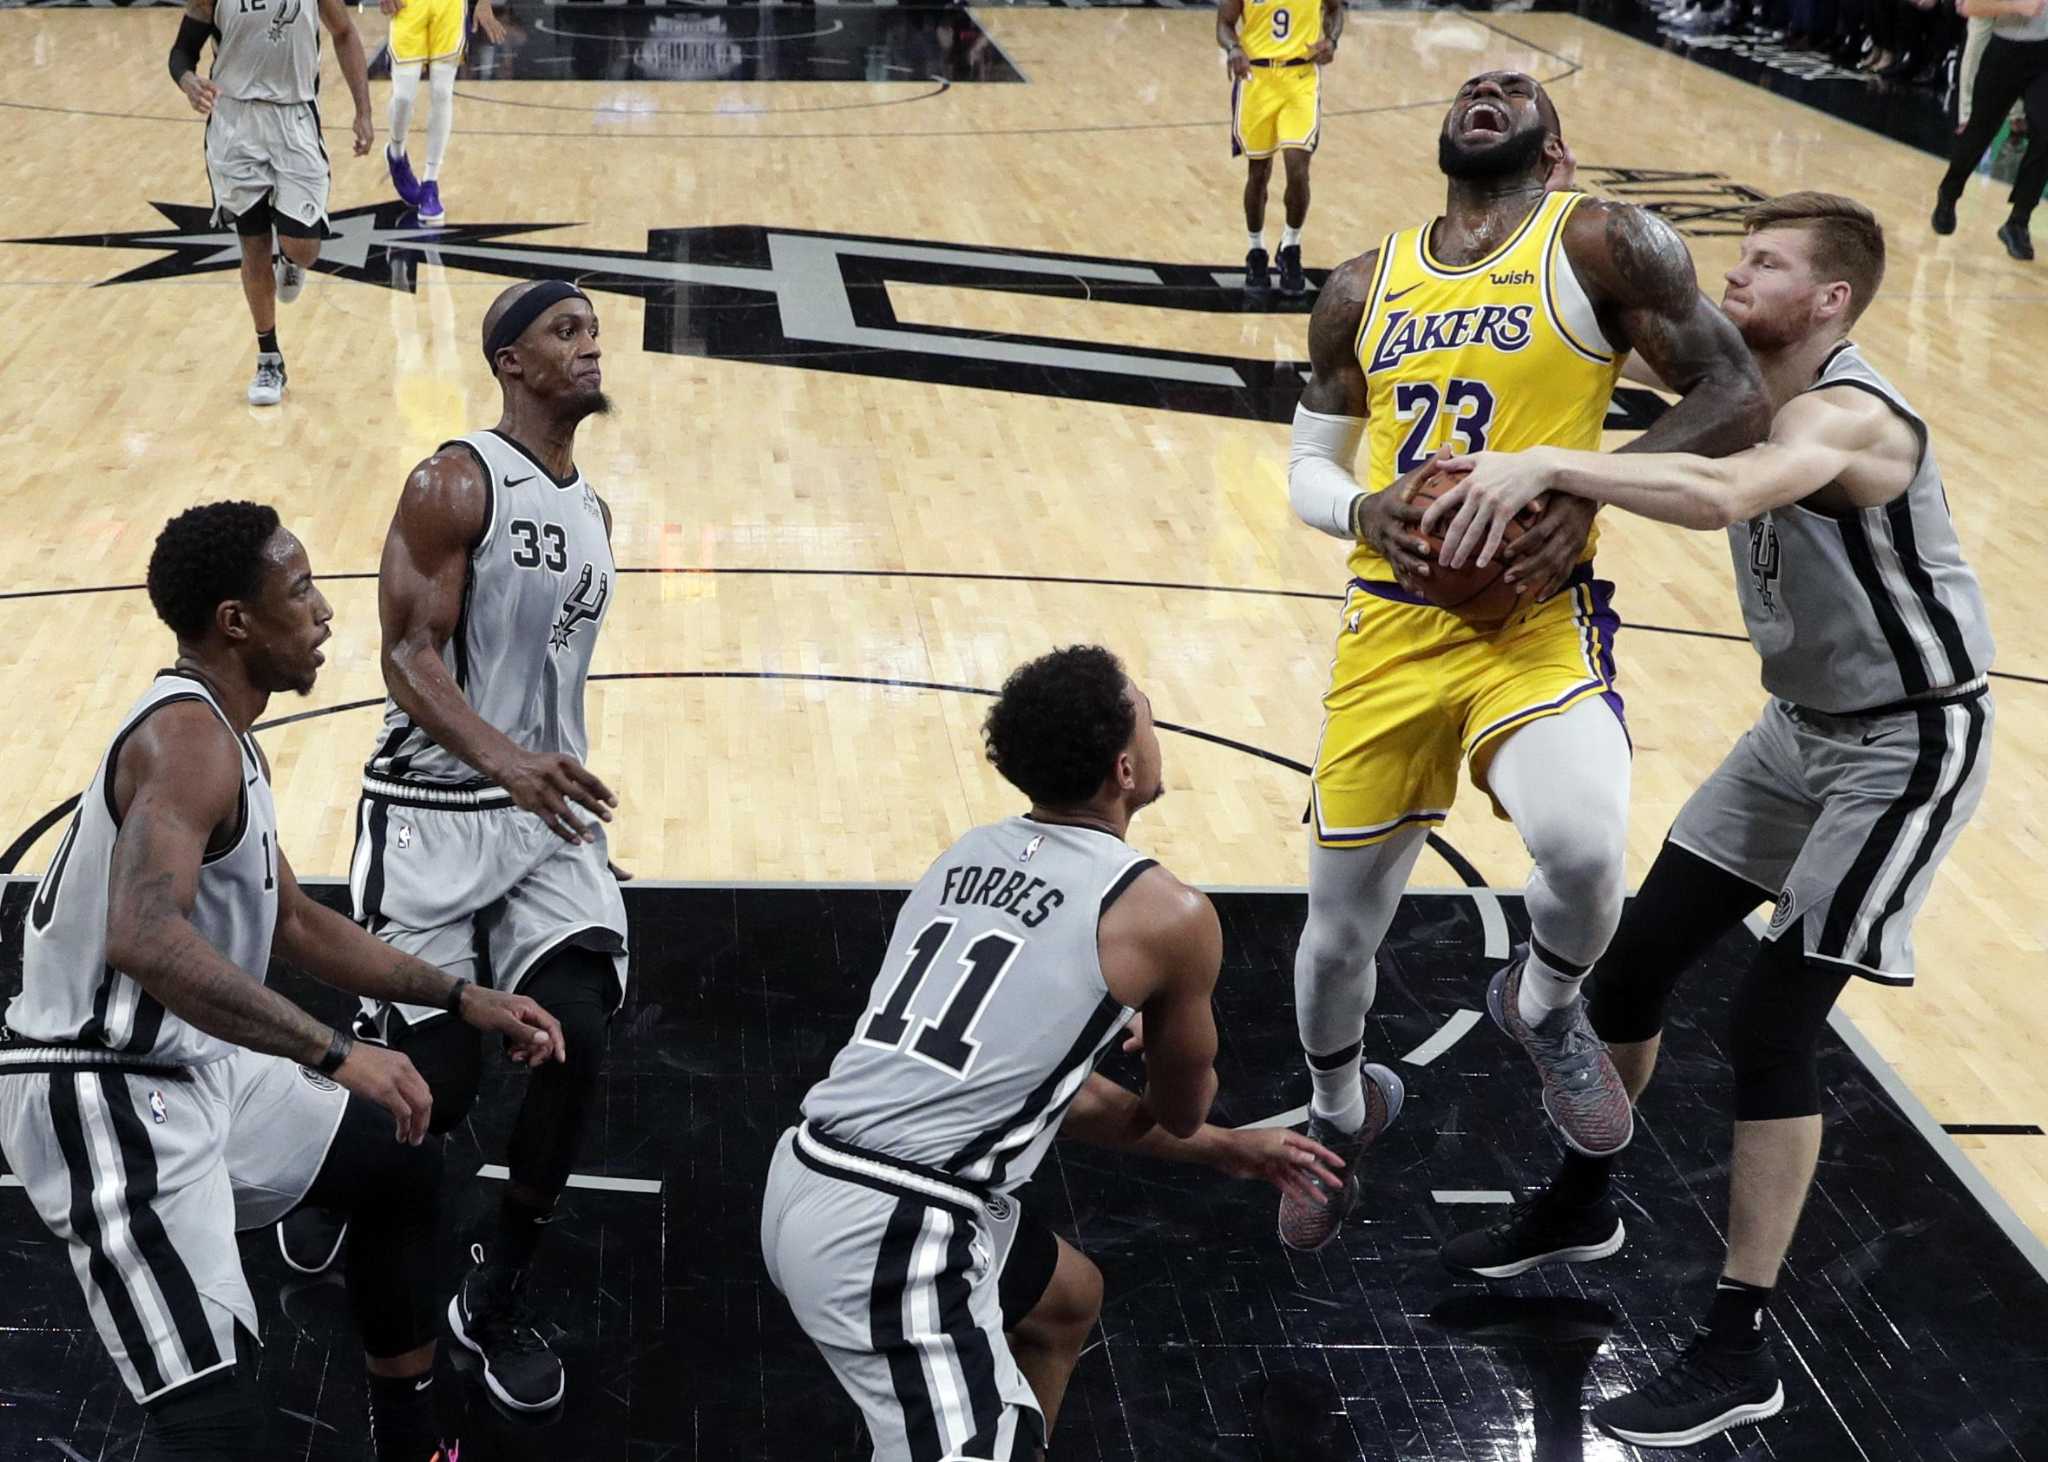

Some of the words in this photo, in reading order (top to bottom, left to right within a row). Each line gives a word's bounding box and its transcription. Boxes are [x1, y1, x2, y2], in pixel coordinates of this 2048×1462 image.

[1272, 8, 1291, 41] 9
[1490, 270, 1535, 286] wish
[1367, 304, 1534, 375] LAKERS
[1395, 377, 1496, 479] 23
[509, 518, 568, 575] 33
[939, 865, 1065, 928] FORBES
[857, 916, 1026, 1081] 11
